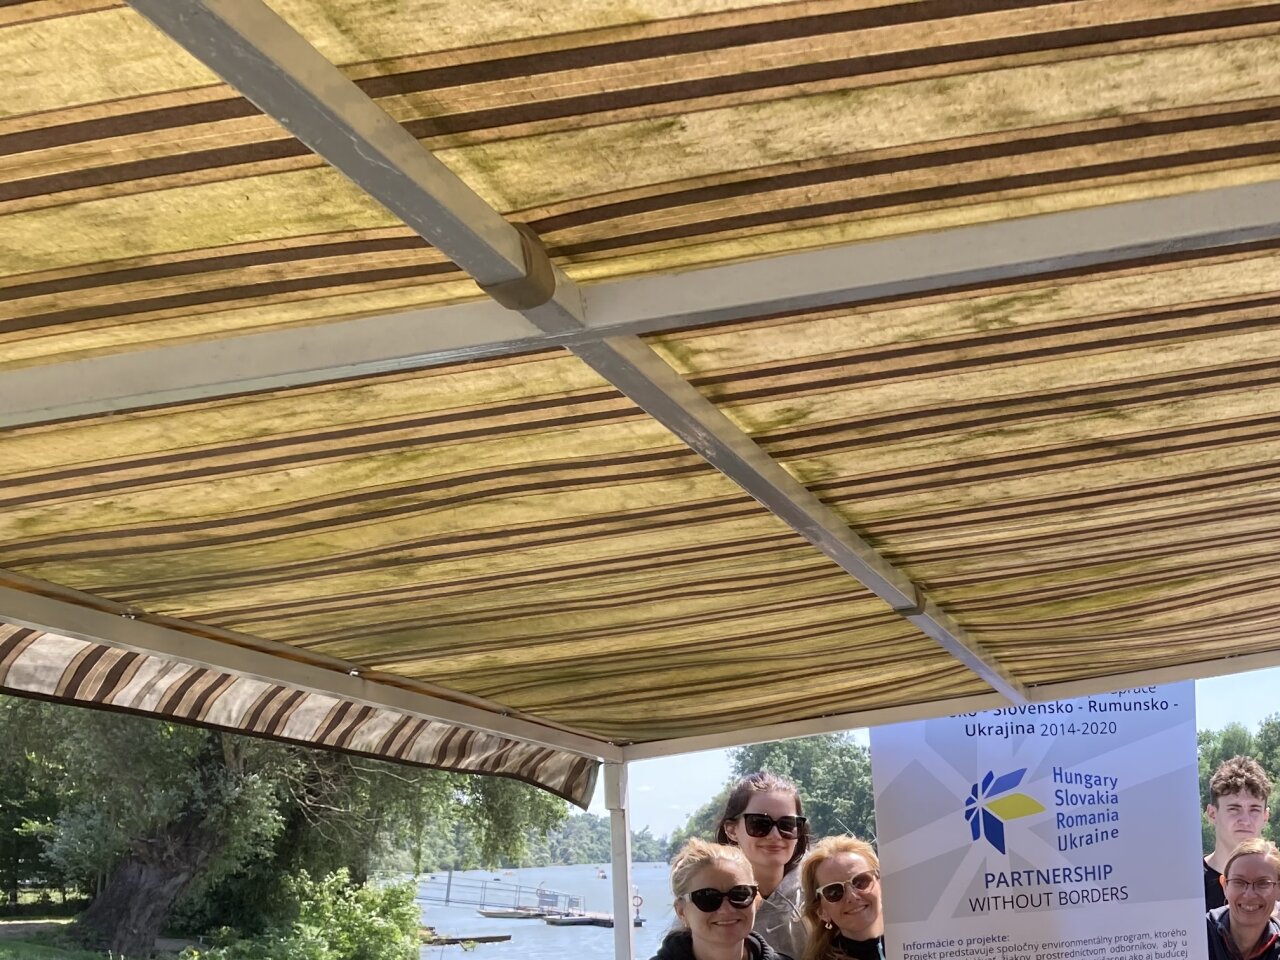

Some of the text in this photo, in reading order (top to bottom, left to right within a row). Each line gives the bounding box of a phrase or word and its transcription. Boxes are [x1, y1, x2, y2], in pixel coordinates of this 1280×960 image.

[1088, 698, 1169, 713] Rumunsko
[964, 721, 1117, 739] Ukrajina 2014-2020
[1052, 766, 1118, 790] Hungary
[1054, 789, 1119, 807] Slovakia
[1056, 808, 1120, 830] Romania
[1057, 827, 1120, 852] Ukraine
[984, 864, 1114, 890] PARTNERSHIP
[968, 885, 1129, 913] WITHOUT BORDERS
[939, 946, 994, 960] predstavuje
[1154, 928, 1187, 938] ktorého
[966, 934, 1010, 947] projekte:
[1162, 939, 1178, 951] aby
